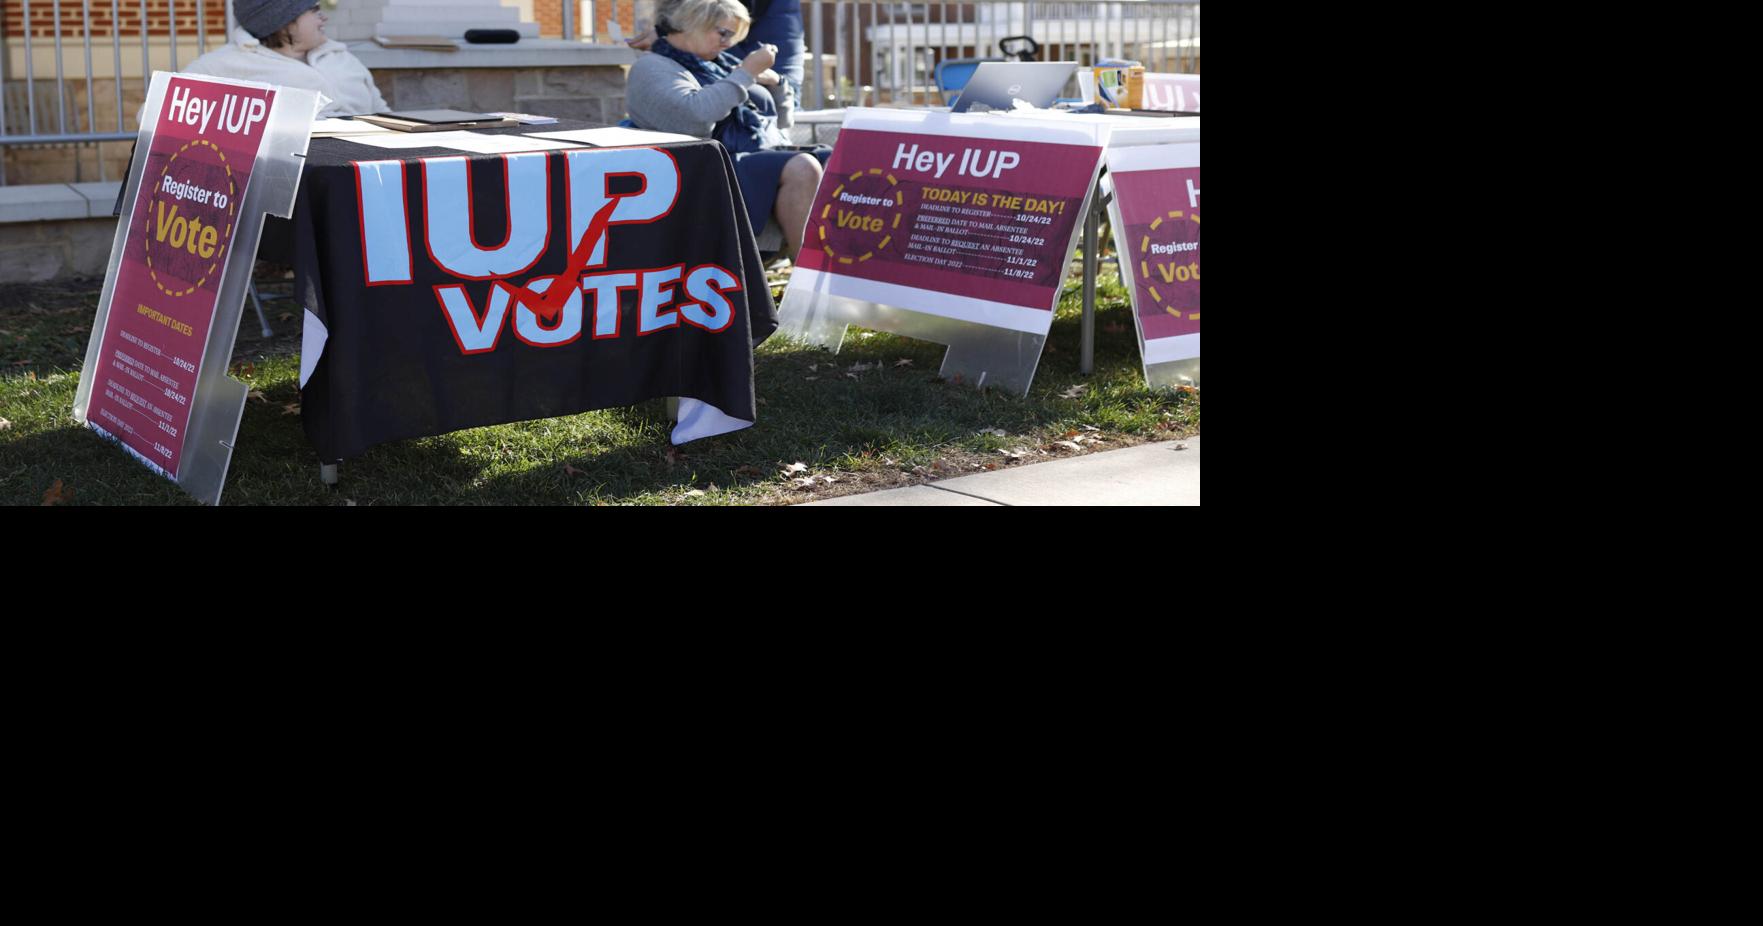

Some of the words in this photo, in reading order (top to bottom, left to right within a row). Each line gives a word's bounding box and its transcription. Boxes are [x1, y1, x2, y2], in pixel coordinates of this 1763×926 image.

[168, 86, 217, 134] Hey
[217, 94, 266, 135] IUP
[892, 143, 955, 179] Hey
[958, 148, 1020, 179] IUP
[161, 175, 212, 203] Register
[213, 191, 228, 209] to
[839, 191, 881, 206] Register
[882, 197, 894, 207] to
[921, 187, 972, 204] TODAY
[971, 193, 988, 206] IS
[991, 195, 1023, 210] THE
[1024, 199, 1066, 215] DAY!
[352, 145, 681, 287] IUP
[837, 209, 884, 232] Vote
[920, 203, 950, 212] DEADLINE
[961, 209, 991, 217] REGISTER
[1016, 214, 1052, 225] 10/24/22
[951, 219, 968, 227] DATE
[978, 222, 994, 230] MAIL
[994, 224, 1028, 234] ABSENTEE
[156, 201, 218, 259] Vote
[944, 226, 969, 236] BALLOT
[1009, 235, 1045, 246] 10/24/22
[932, 245, 957, 255] BALLOT
[1006, 256, 1037, 267] 11/1/22
[941, 237, 951, 245] TO
[950, 239, 979, 250] REQUEST
[1151, 241, 1199, 255] Register
[904, 253, 935, 263] ELECTION
[934, 257, 947, 266] DAY
[947, 259, 963, 268] 2022
[1004, 268, 1034, 279] 11/8/22
[137, 304, 171, 327] IMPORTANT
[171, 317, 193, 337] DATES
[432, 262, 744, 356] VOTES
